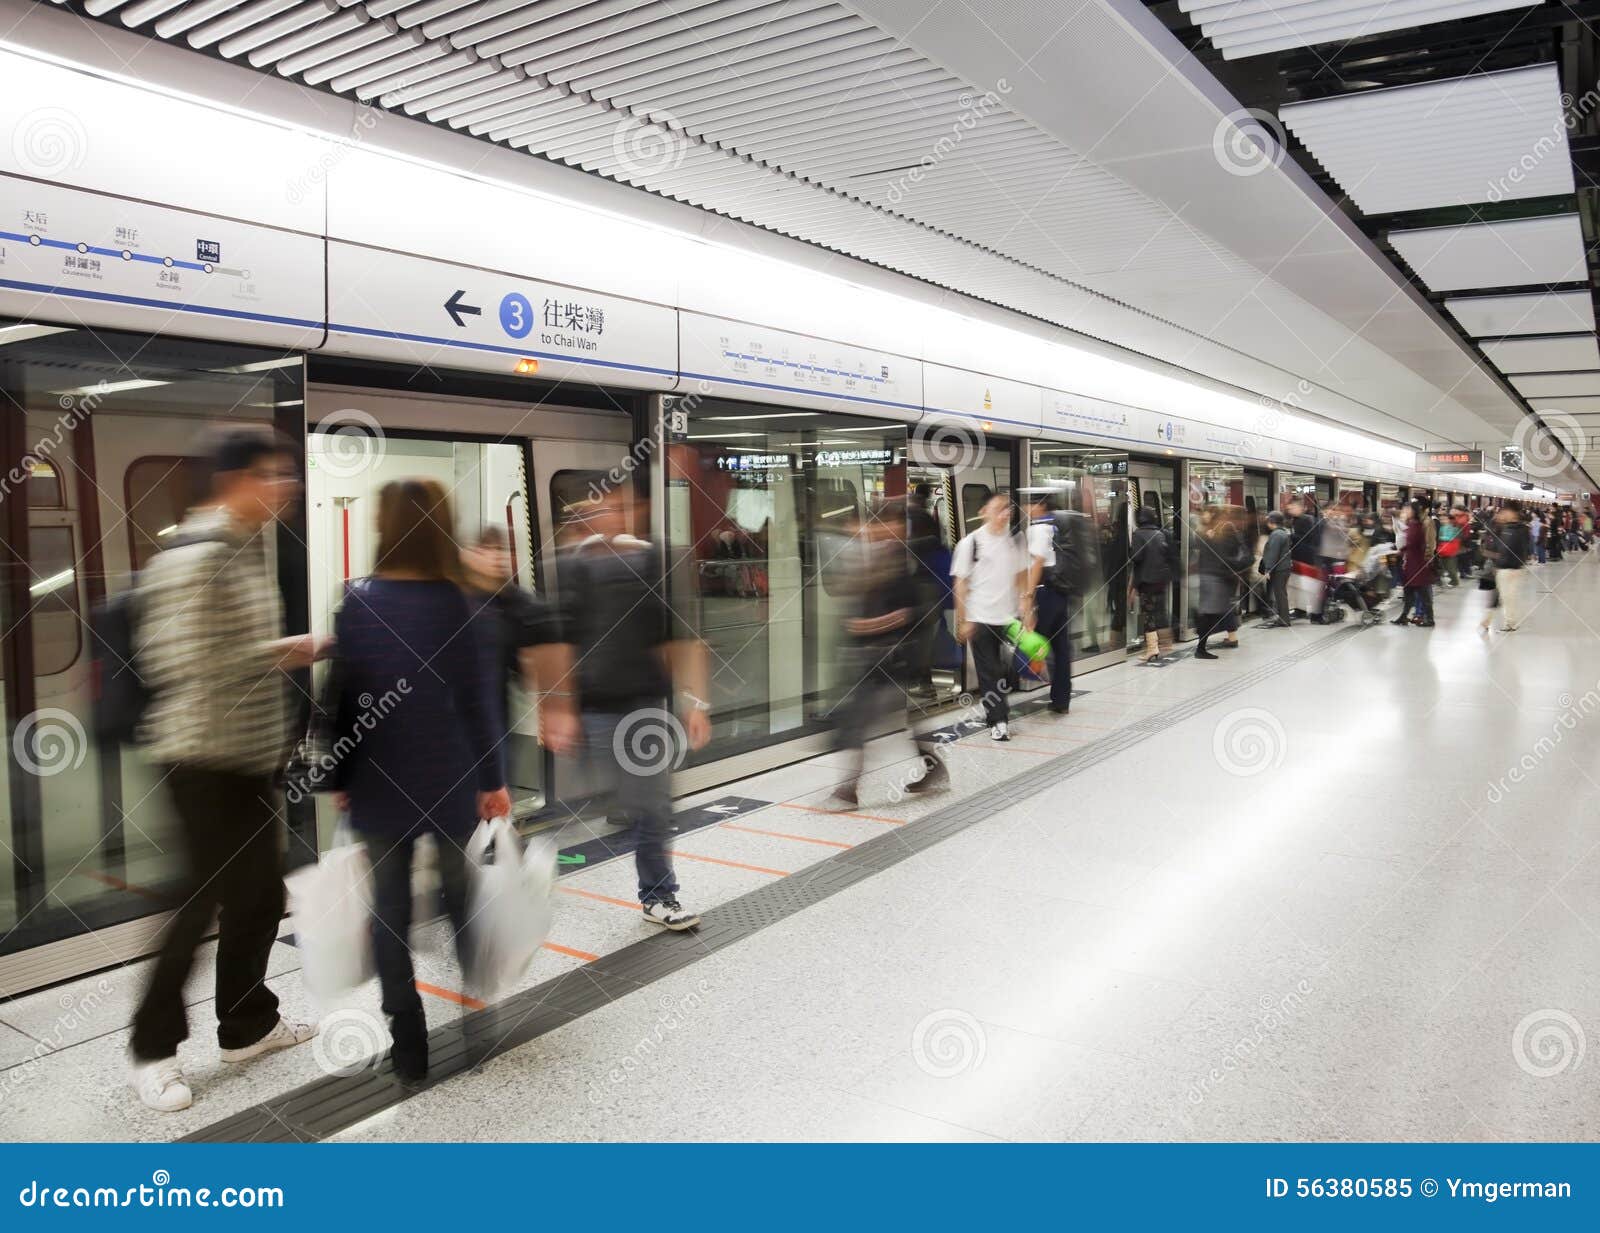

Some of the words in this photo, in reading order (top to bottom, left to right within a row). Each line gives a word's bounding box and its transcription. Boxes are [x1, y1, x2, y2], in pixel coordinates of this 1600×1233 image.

[23, 210, 48, 225] 天后
[197, 240, 219, 254] 中環
[509, 301, 524, 331] 3
[543, 298, 605, 336] 往柴灣
[541, 333, 552, 344] to
[554, 334, 576, 349] Chai
[577, 337, 597, 351] Wan
[676, 415, 683, 430] 3
